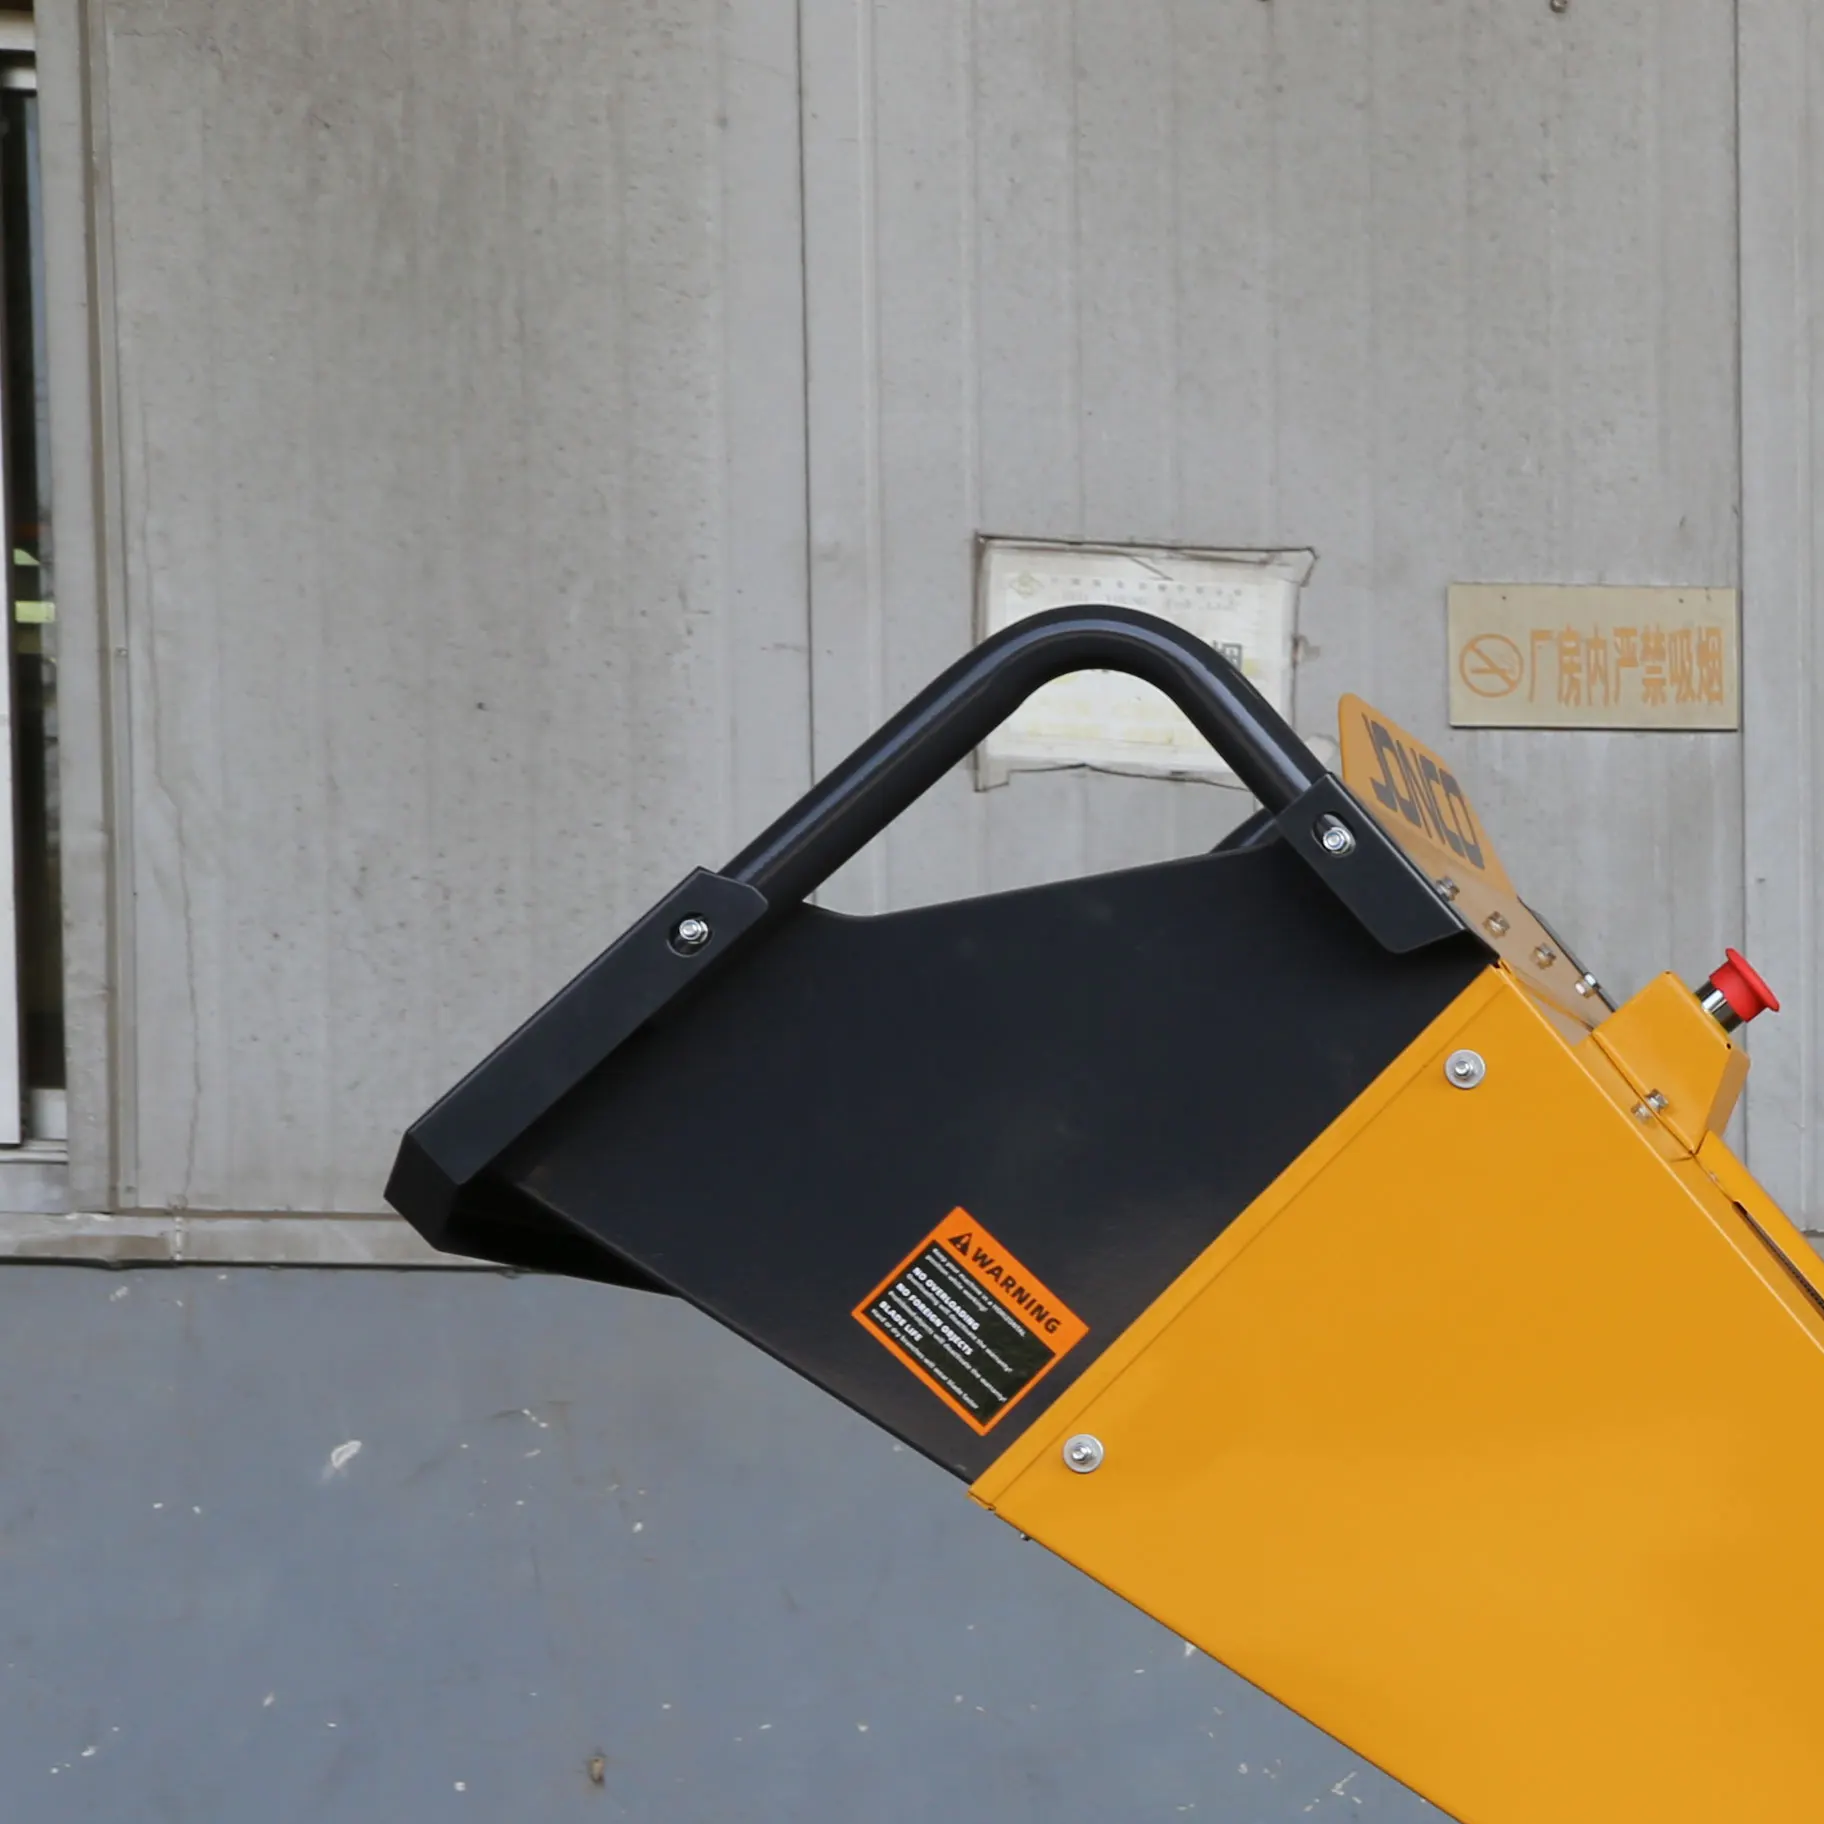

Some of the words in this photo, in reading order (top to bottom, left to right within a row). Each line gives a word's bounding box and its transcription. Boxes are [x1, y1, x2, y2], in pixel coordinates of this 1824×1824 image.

[1527, 622, 1724, 707] 厂房内严禁吸烟
[1361, 711, 1486, 871] JONCO
[878, 1300, 908, 1327] BLADE
[903, 1323, 924, 1342] LIFE
[895, 1282, 911, 1297] NO
[907, 1294, 944, 1328] FOREIGN
[940, 1324, 974, 1356] OBJECTS
[912, 1266, 928, 1281] NO
[924, 1278, 981, 1331] OVERLOADING
[971, 1247, 1061, 1334] WARNING
